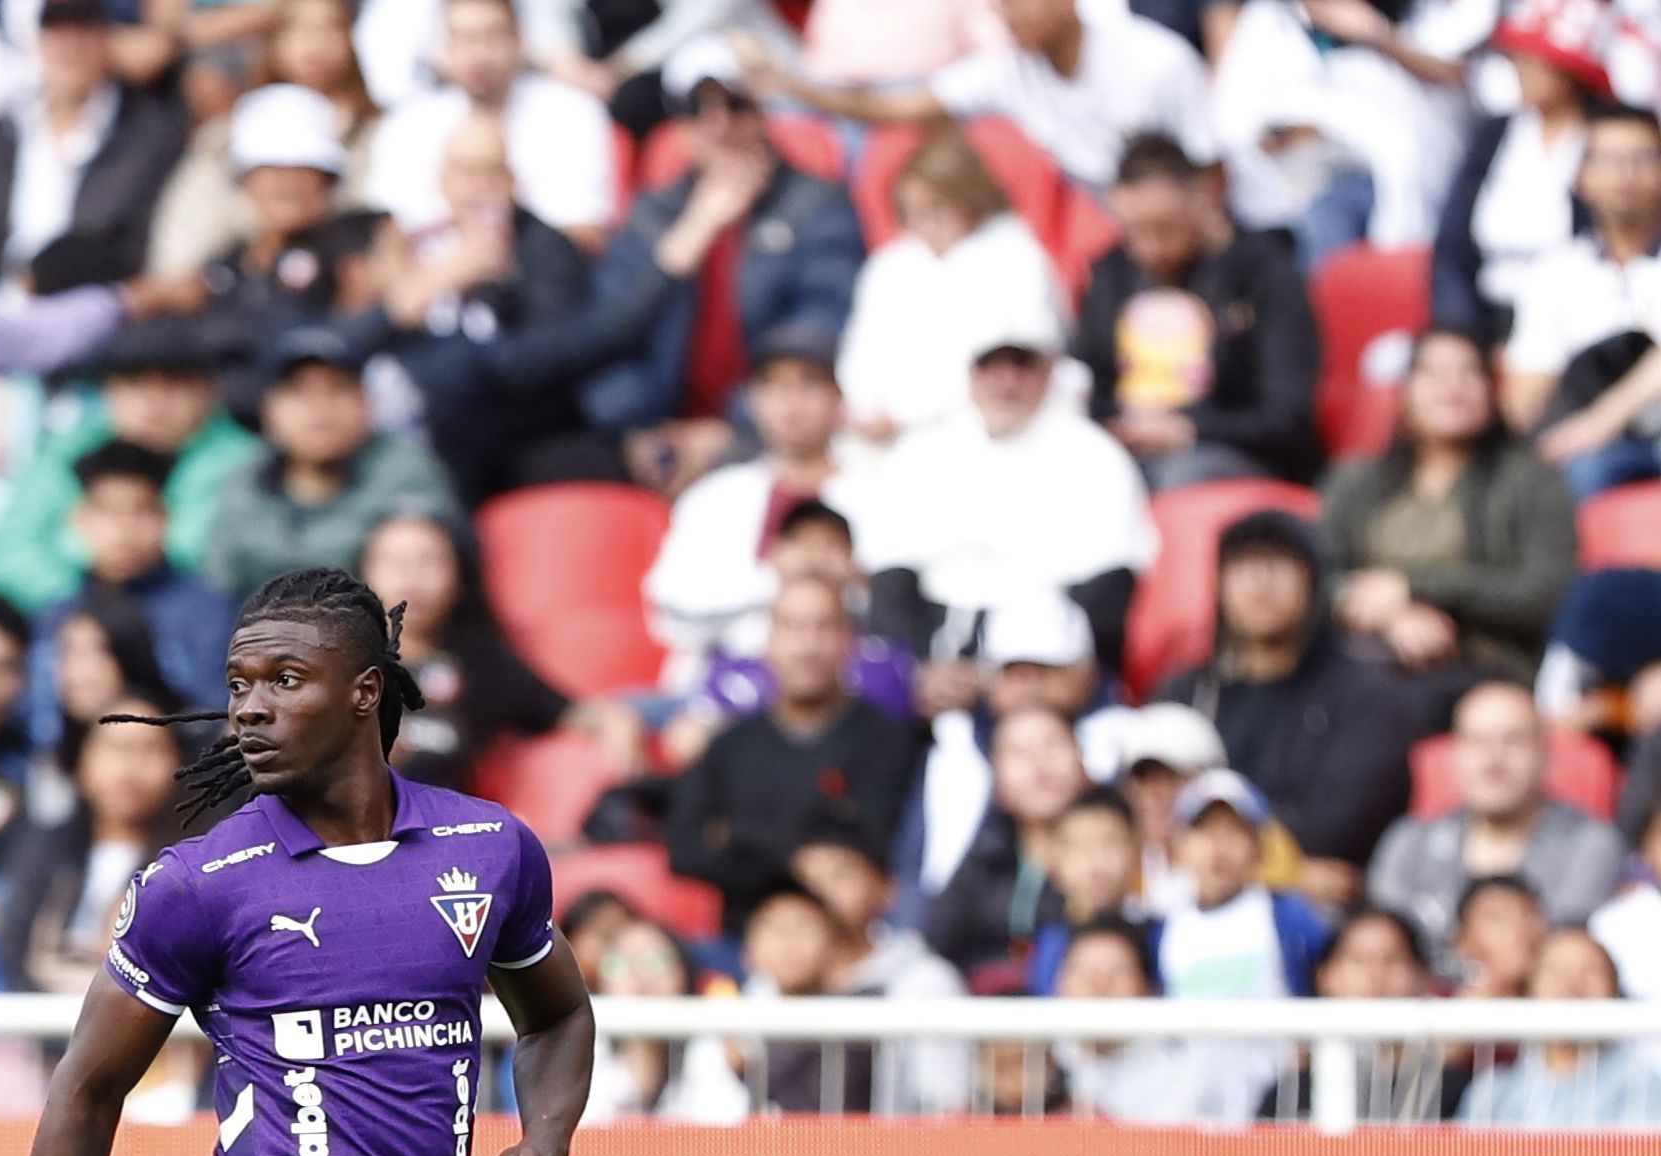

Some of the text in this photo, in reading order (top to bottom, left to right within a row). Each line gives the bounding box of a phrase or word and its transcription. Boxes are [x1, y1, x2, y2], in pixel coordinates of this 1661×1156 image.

[432, 821, 504, 837] CHERY
[201, 841, 276, 873] CHERY
[333, 1000, 436, 1029] BANCO
[333, 1020, 474, 1056] PICHINCHA
